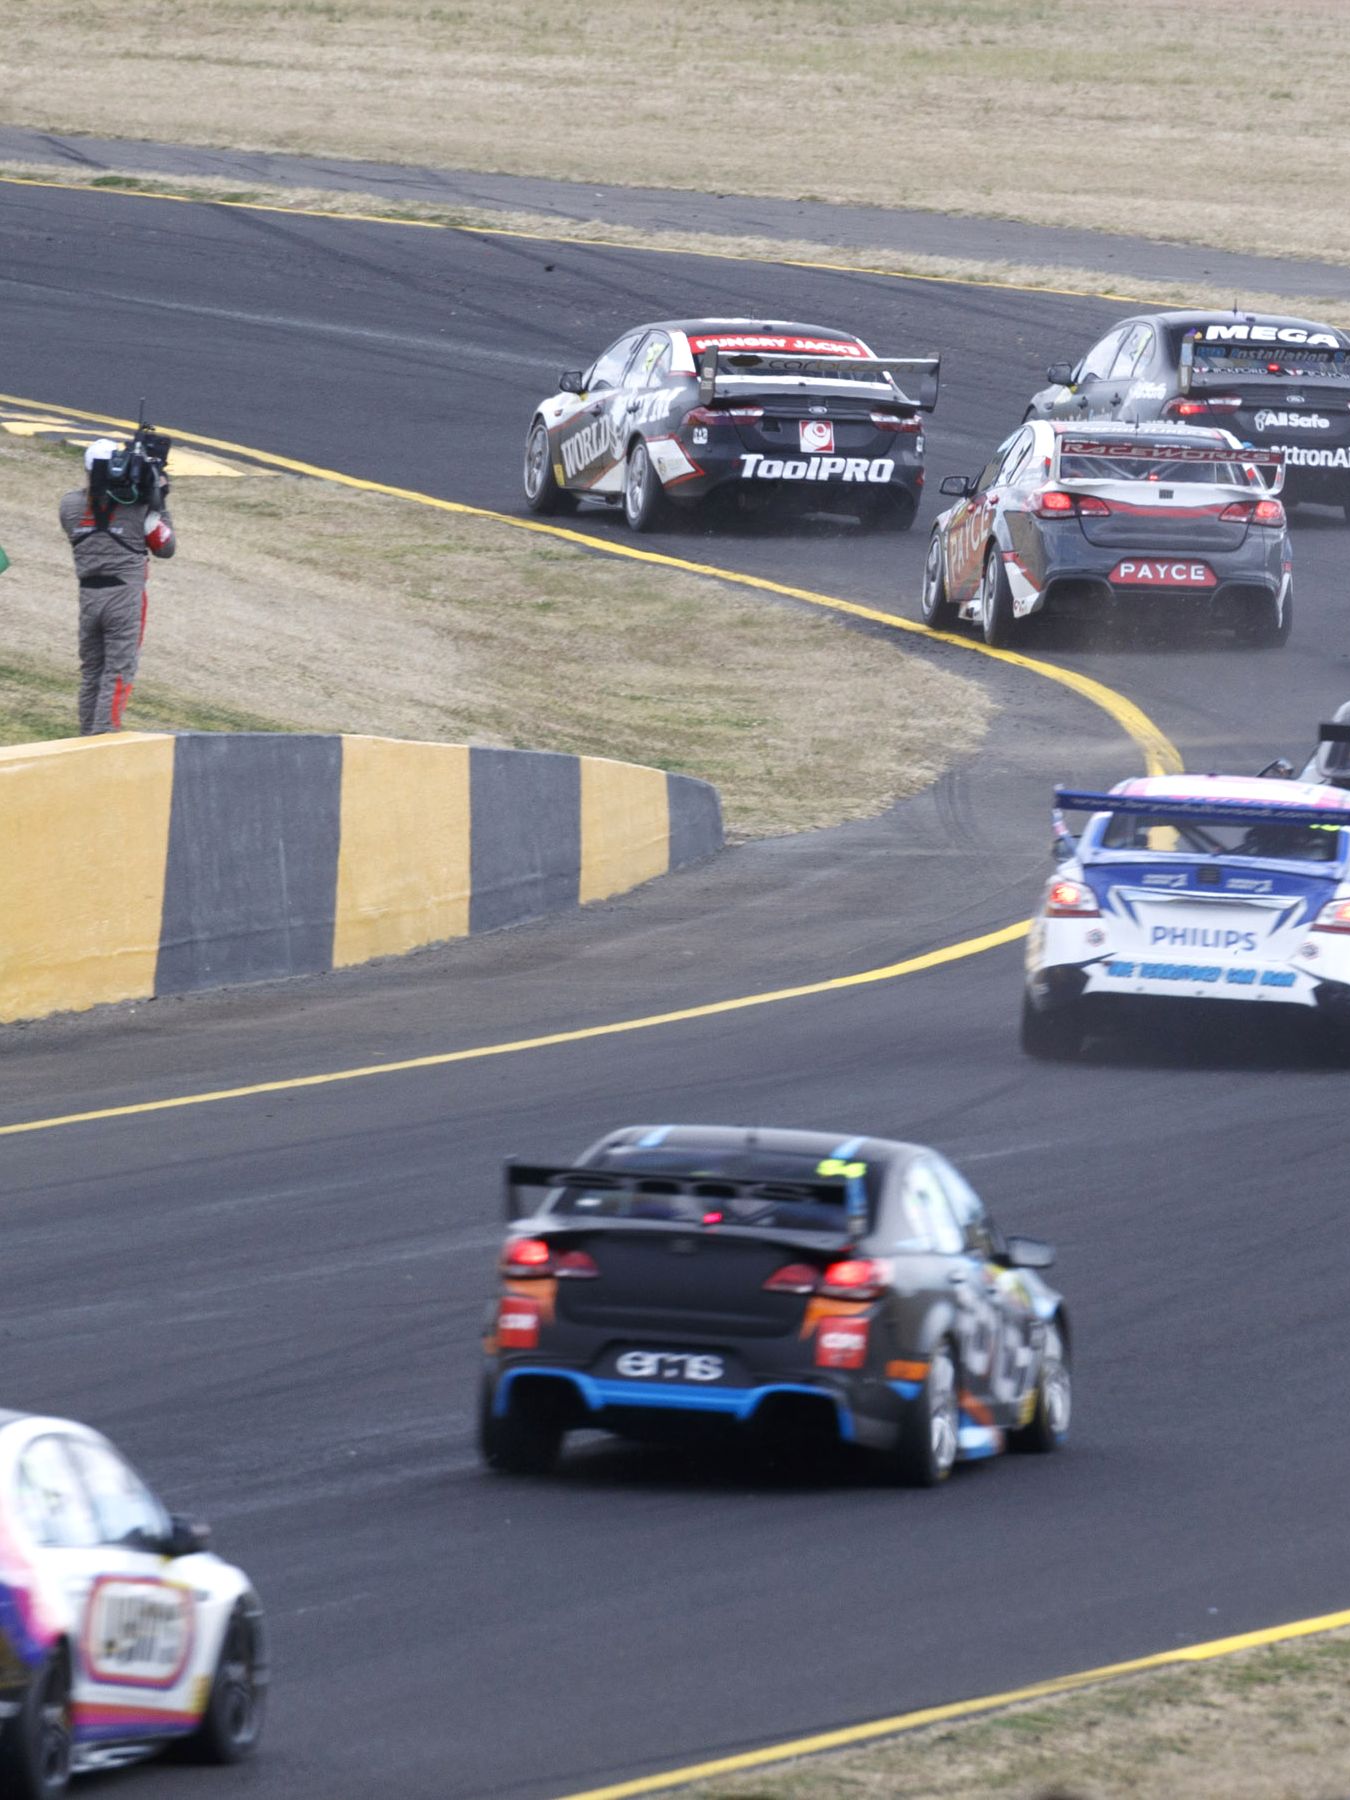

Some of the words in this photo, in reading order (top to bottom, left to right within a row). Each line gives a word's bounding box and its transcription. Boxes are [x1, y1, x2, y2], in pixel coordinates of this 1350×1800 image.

[696, 337, 786, 351] HUNGRY
[1205, 325, 1340, 348] MEGA
[1062, 443, 1271, 463] RACEWORKS
[740, 454, 894, 483] ToolPRO
[1120, 564, 1206, 581] PAYCE
[1151, 926, 1256, 951] PHILIPS
